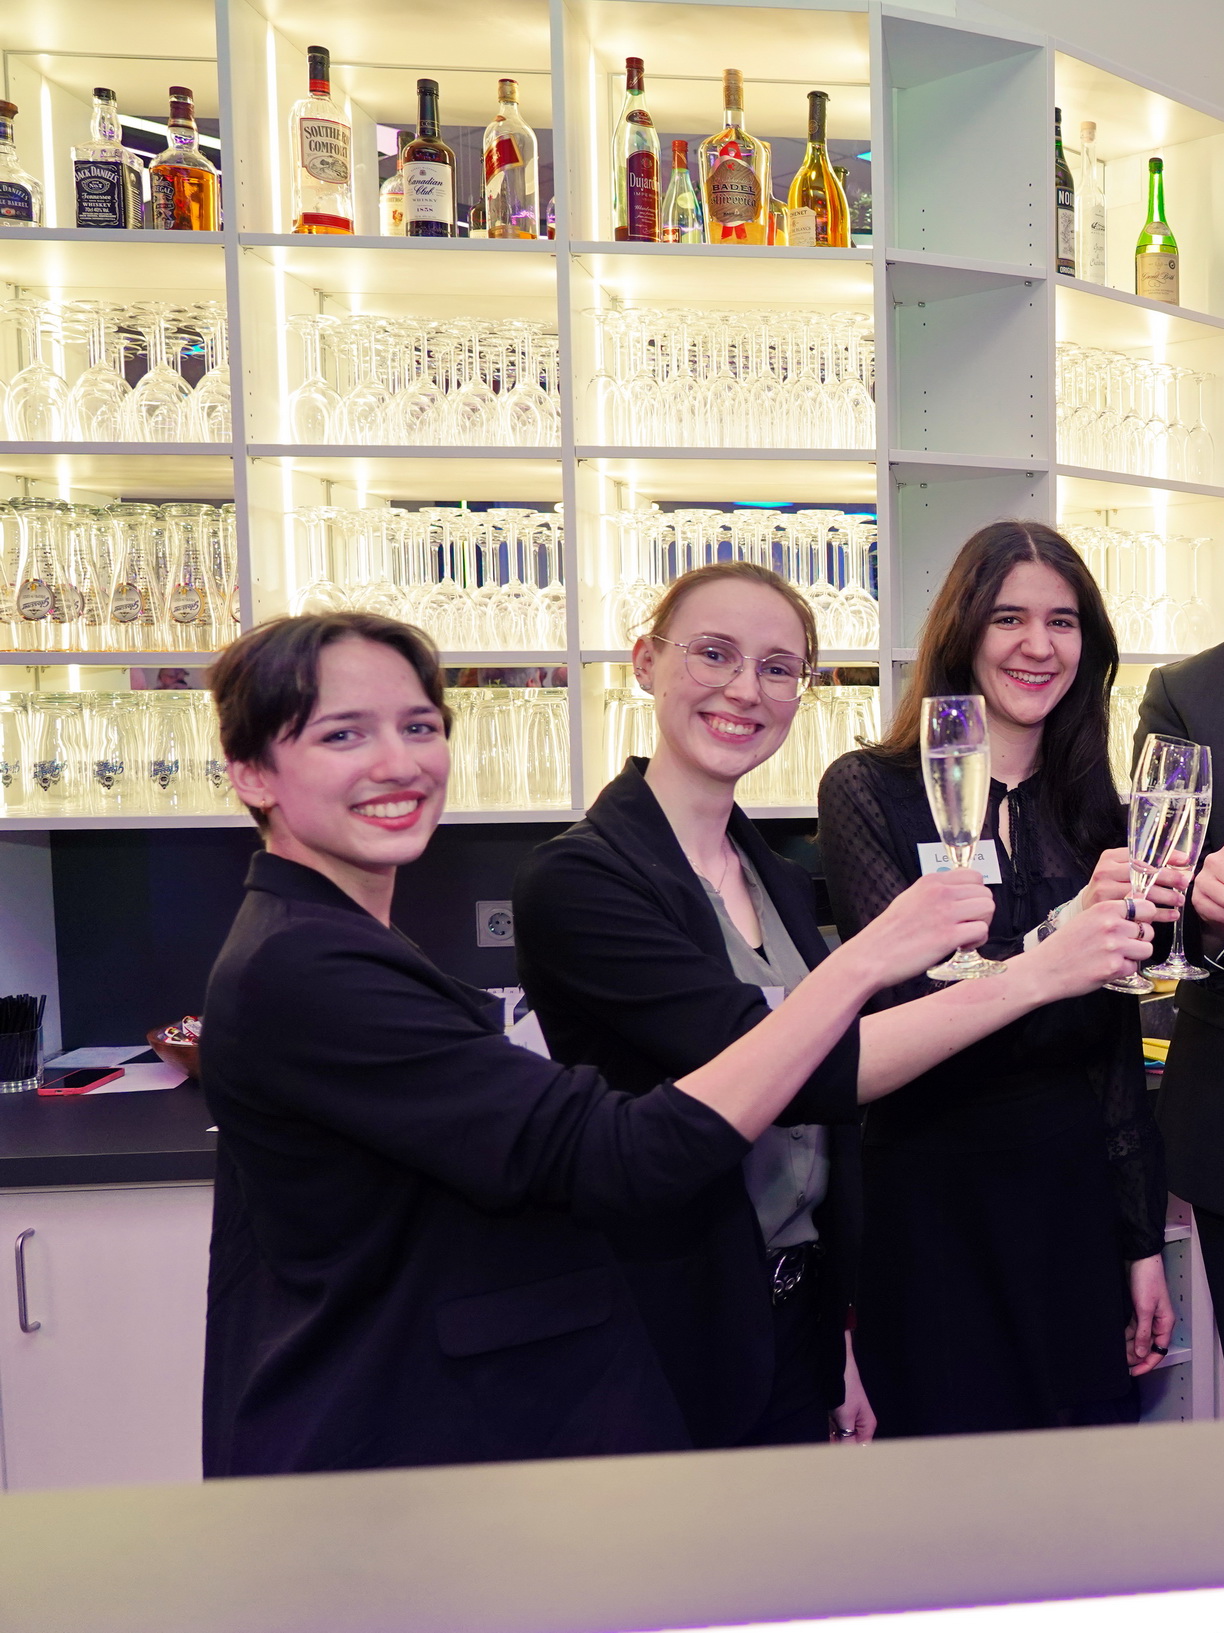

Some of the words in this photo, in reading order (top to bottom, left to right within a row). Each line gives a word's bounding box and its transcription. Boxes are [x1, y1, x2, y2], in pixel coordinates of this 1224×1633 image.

[308, 139, 348, 158] COMFORT
[75, 169, 91, 182] JACK
[407, 175, 443, 187] Canadian
[414, 185, 434, 196] Club
[712, 183, 756, 194] BADEL
